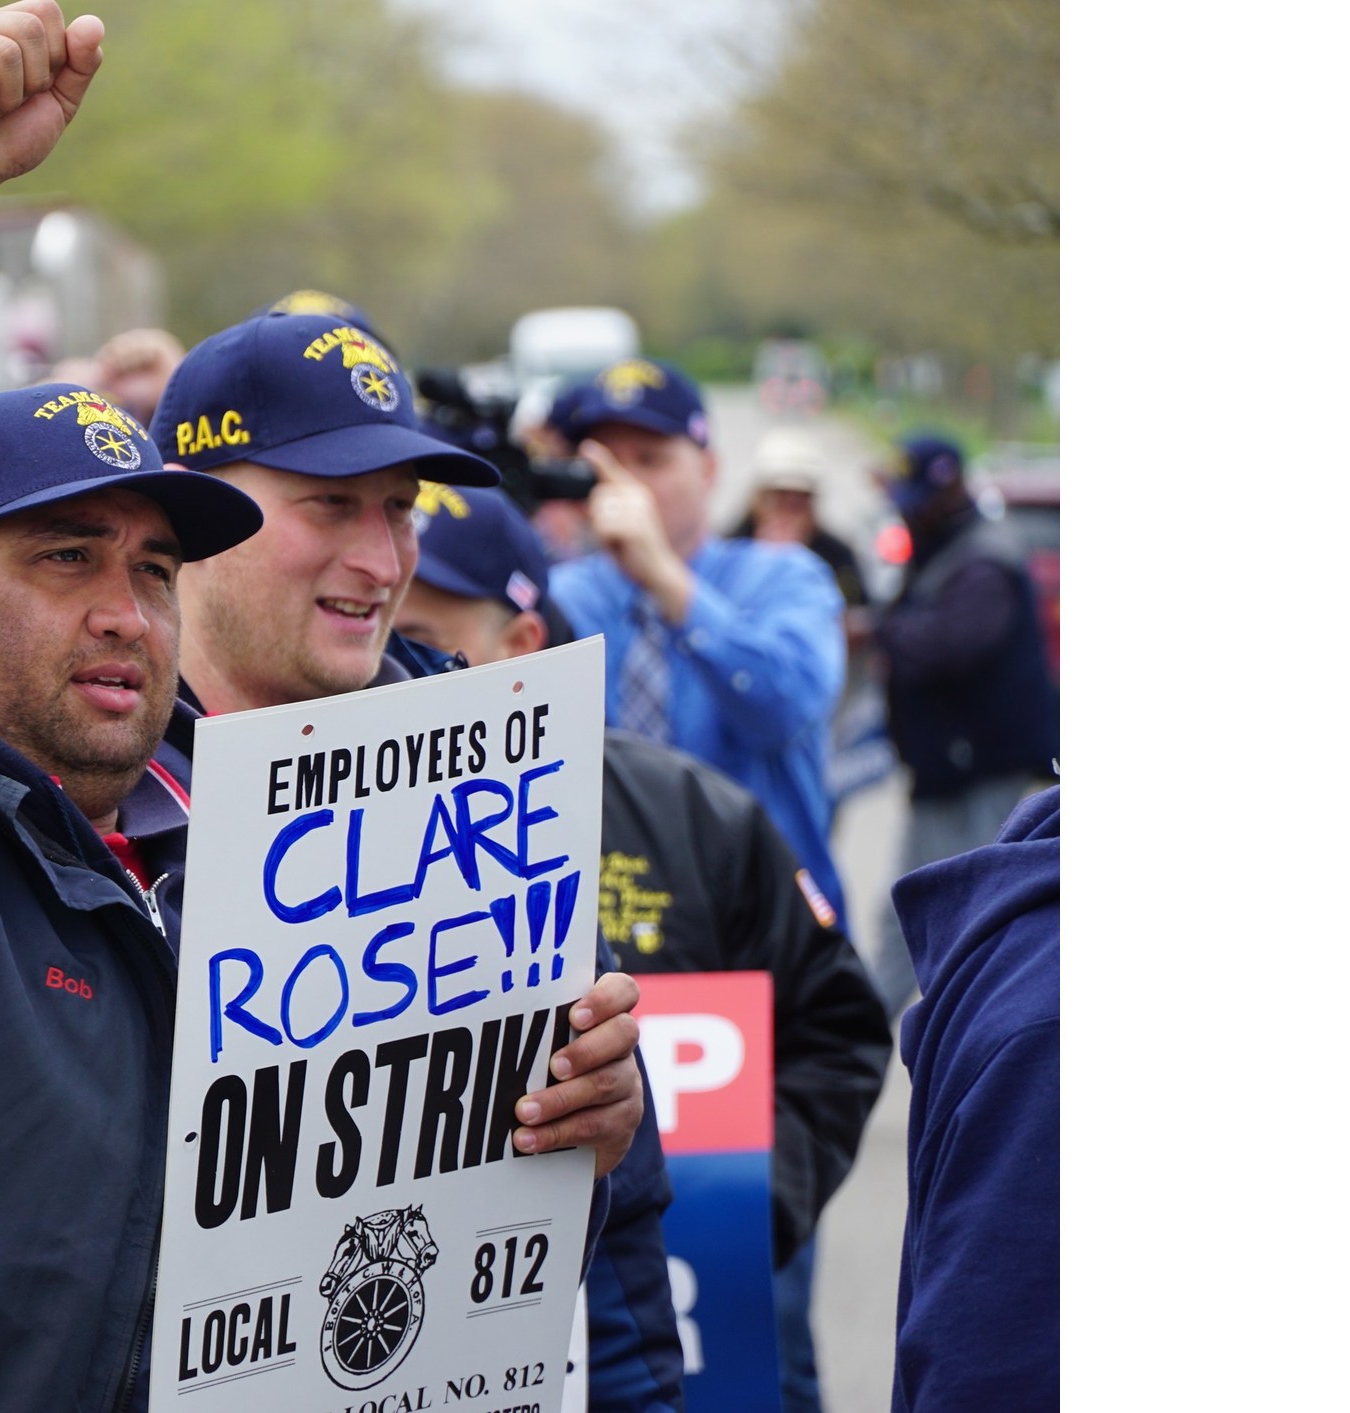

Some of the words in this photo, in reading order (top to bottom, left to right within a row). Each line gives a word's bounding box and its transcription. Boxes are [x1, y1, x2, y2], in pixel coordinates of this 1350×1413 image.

[176, 410, 250, 456] P.A.C.
[267, 720, 487, 815] EMPLOYEES
[505, 703, 549, 764] OF
[263, 759, 570, 924] CLARE
[46, 966, 93, 999] Bob
[209, 870, 581, 1063] ROSE!!!
[195, 1059, 307, 1229] ON
[470, 1233, 549, 1303] 812
[178, 1294, 297, 1382] LOCAL
[344, 1386, 432, 1413] OCAL
[443, 1373, 489, 1404] NO.
[503, 1362, 545, 1391] 812
